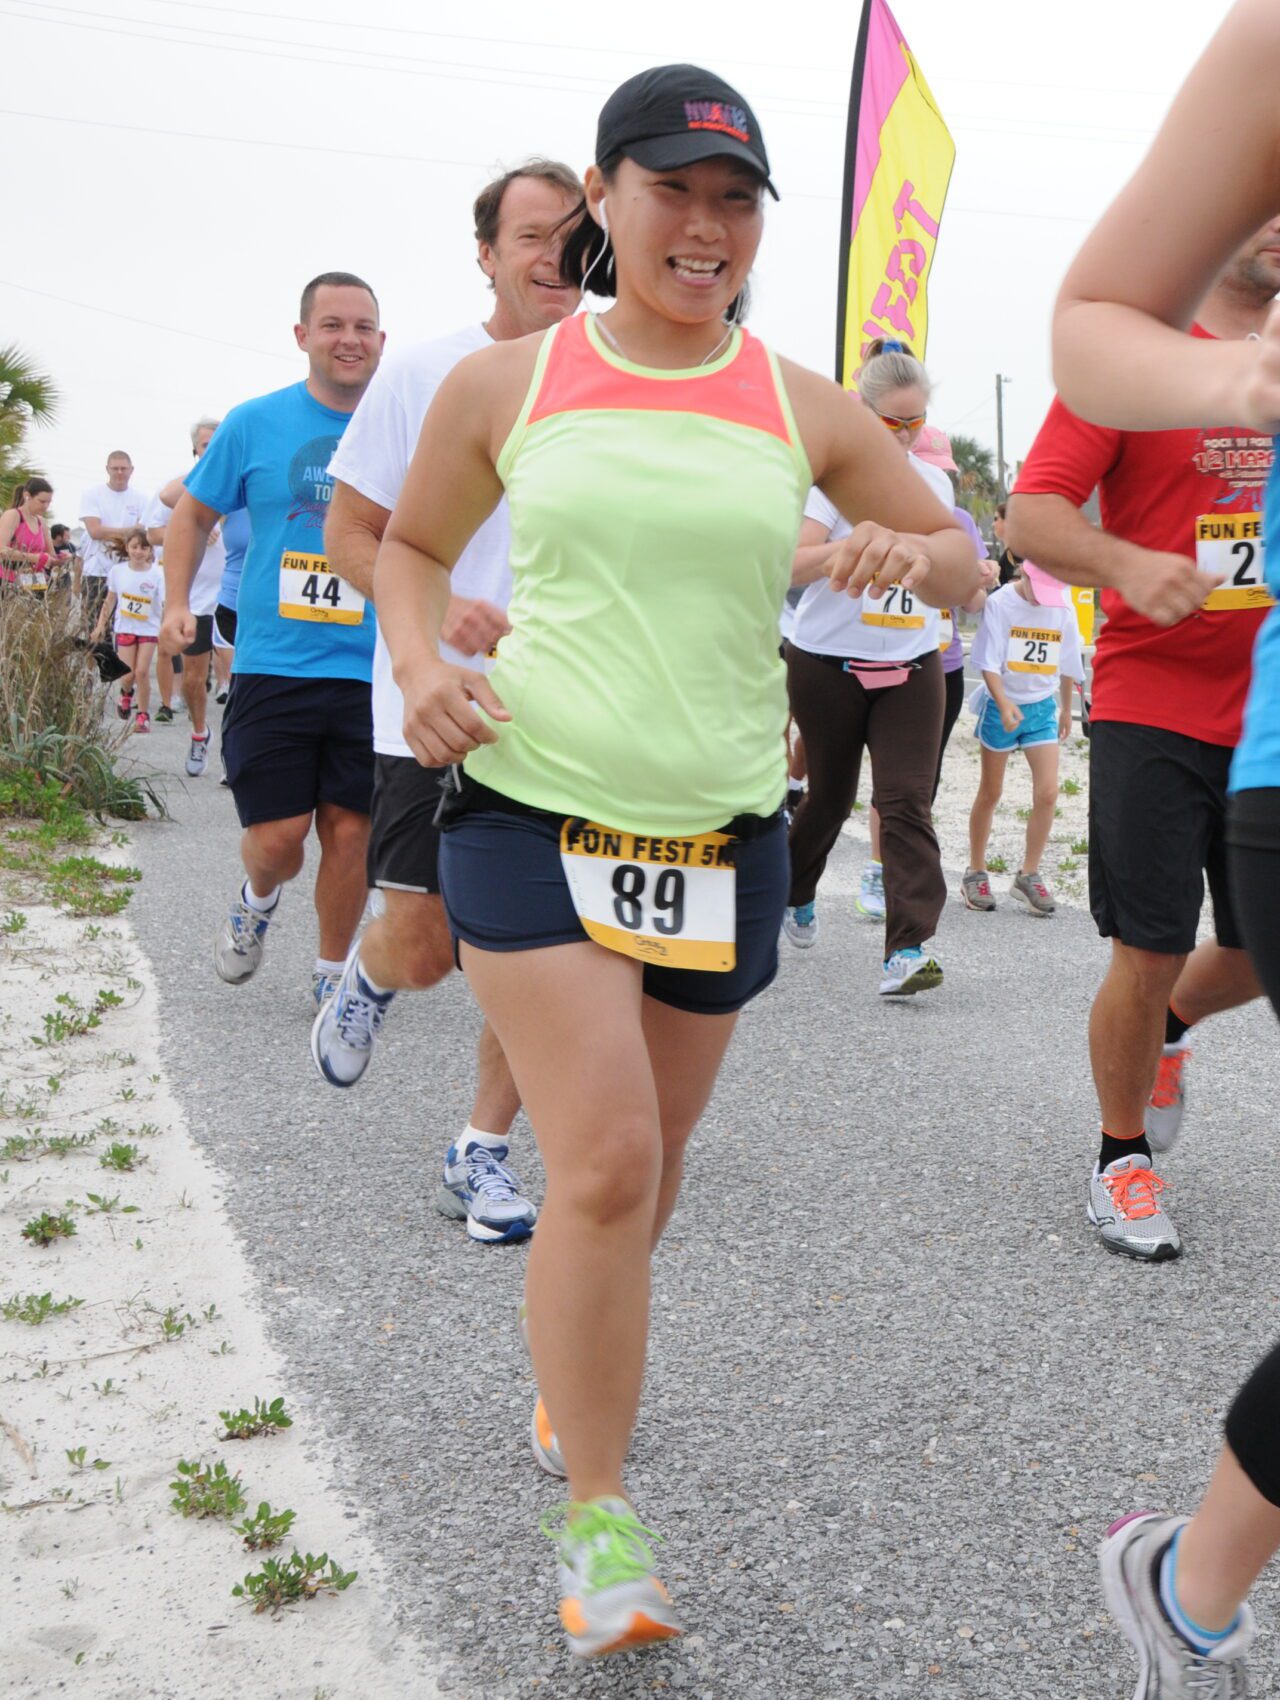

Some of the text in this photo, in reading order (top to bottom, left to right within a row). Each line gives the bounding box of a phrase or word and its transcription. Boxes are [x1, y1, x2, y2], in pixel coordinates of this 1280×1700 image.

[1200, 523, 1235, 539] FUN
[282, 557, 308, 570] FUN
[1231, 541, 1267, 586] 2
[301, 573, 341, 607] 44
[883, 586, 913, 614] 76
[127, 601, 143, 614] 42
[1010, 629, 1062, 643] FUN FEST 5K
[1023, 640, 1048, 664] 25
[567, 829, 622, 857] FUN
[631, 836, 695, 865] FEST
[611, 863, 686, 936] 89
